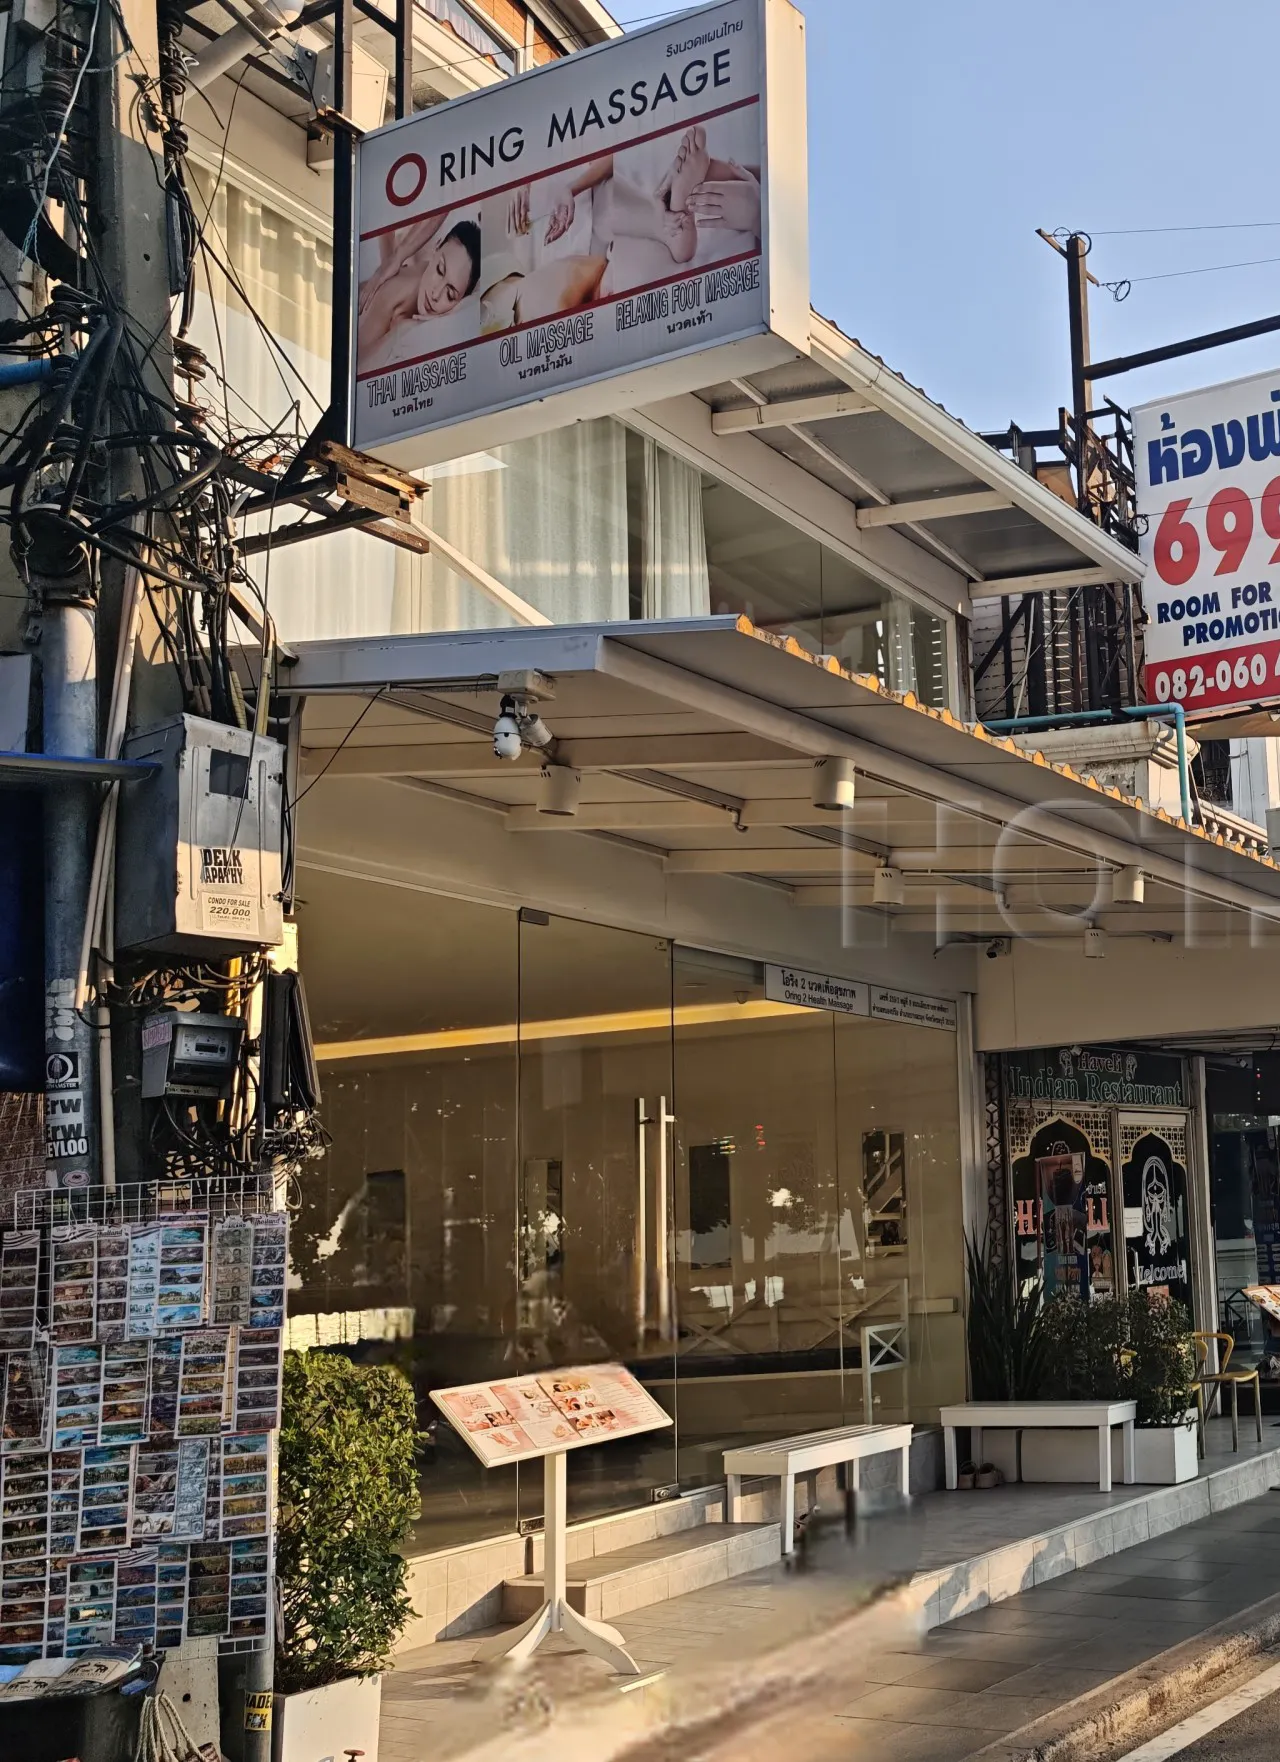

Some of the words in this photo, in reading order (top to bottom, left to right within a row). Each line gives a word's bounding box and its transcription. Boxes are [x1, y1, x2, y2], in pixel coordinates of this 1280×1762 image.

[439, 127, 525, 187] RING
[547, 49, 732, 149] MASSAGE
[616, 290, 669, 332] RELAXING
[671, 278, 702, 315] FOOT
[704, 260, 760, 303] MASSAGE
[667, 310, 713, 335] นวดเท้า
[500, 335, 523, 368] OIL
[526, 312, 594, 362] MASSAGE
[367, 378, 397, 408] THAI
[401, 353, 467, 398] MASSAGE
[517, 353, 573, 381] นวดน้ำมัน
[392, 396, 434, 418] นวดไทย
[1157, 592, 1220, 624] ROOM
[1231, 581, 1272, 609] FOR
[1155, 653, 1266, 702] 082-060
[209, 906, 250, 916] 220.000
[801, 978, 806, 987] 2
[803, 993, 807, 1002] 2
[808, 993, 827, 1006] Health
[828, 997, 854, 1011] Massage
[1078, 1052, 1123, 1073] Haveli
[1009, 1066, 1080, 1100] Indian
[1085, 1071, 1183, 1106] Restaurant
[1133, 1263, 1184, 1284] Welcome
